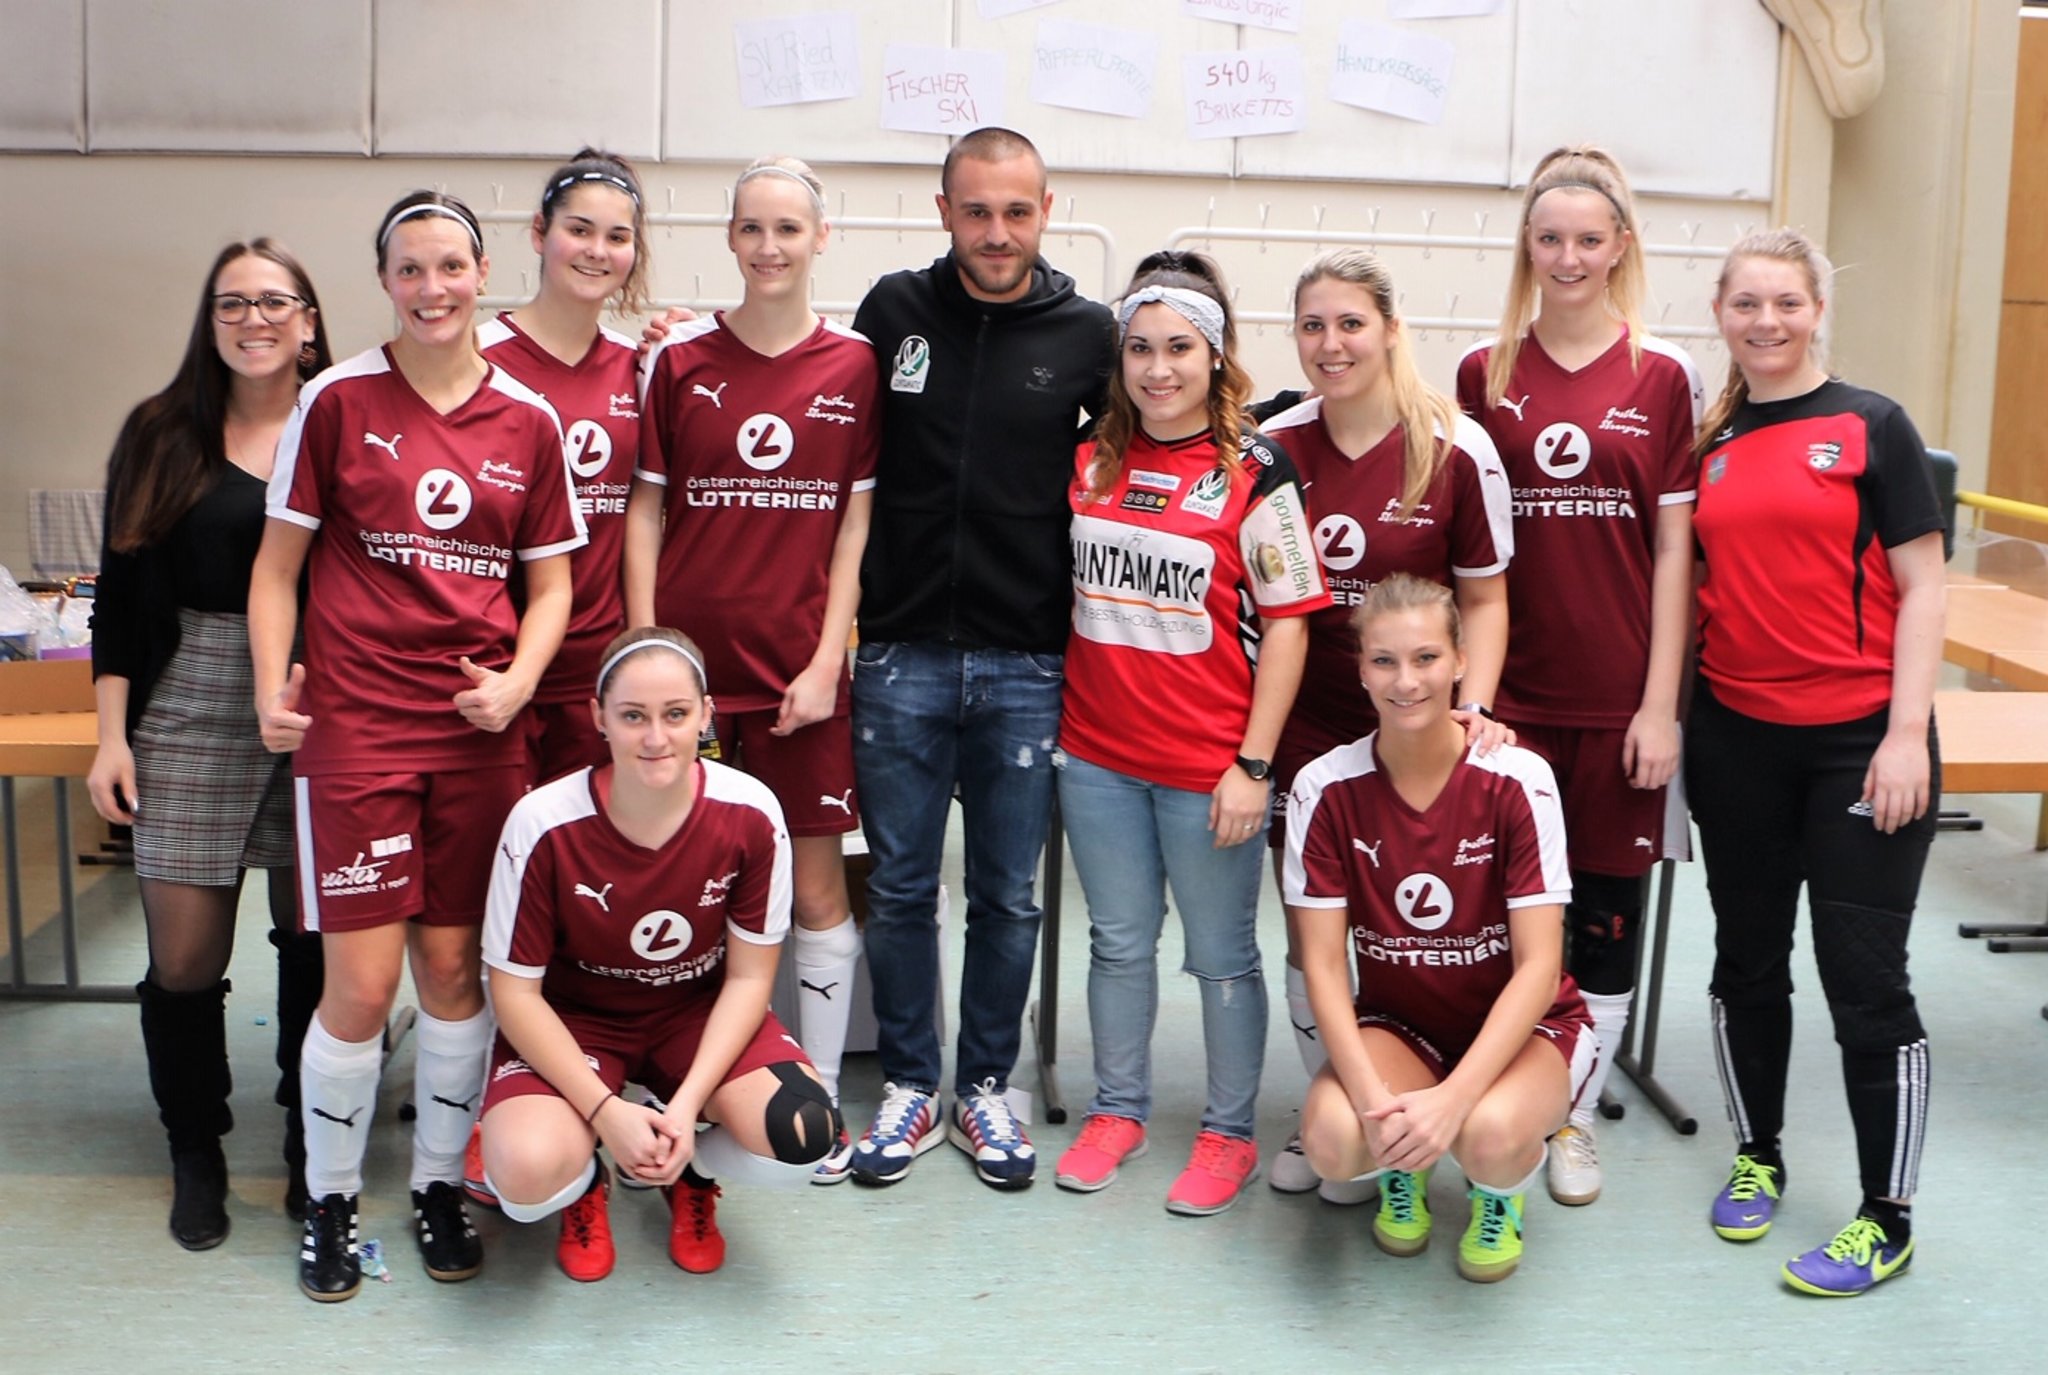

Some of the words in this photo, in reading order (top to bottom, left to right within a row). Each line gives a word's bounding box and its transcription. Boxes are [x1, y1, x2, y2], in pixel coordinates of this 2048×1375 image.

[742, 38, 772, 78] SV
[775, 27, 834, 70] Ried
[885, 69, 970, 103] FISCHER
[1205, 60, 1249, 87] 540
[1258, 60, 1277, 93] kg
[937, 98, 979, 124] SKI
[1194, 98, 1294, 125] BRIKETTS
[686, 476, 839, 492] österreichische
[687, 491, 837, 510] LOTTERIEN
[1512, 501, 1636, 518] OTTERIEN
[359, 529, 513, 560] österreichische
[366, 543, 509, 579] LOTTERIEN
[1072, 539, 1205, 603] UNTAMATIC
[1355, 936, 1511, 966] LOTTERIEN
